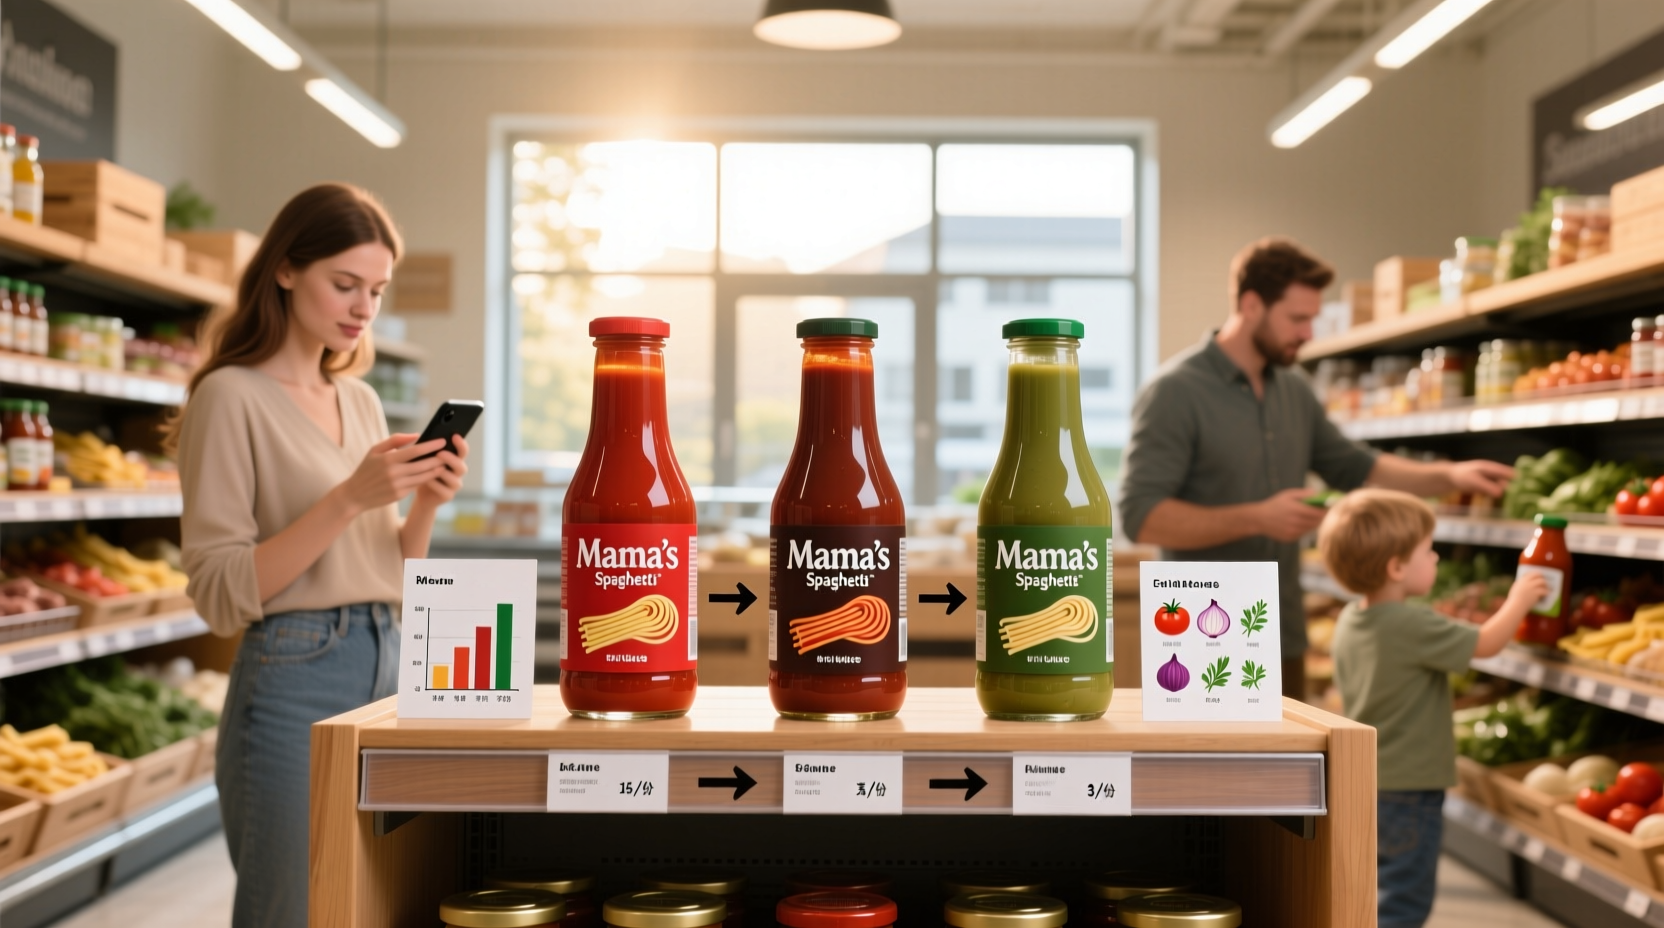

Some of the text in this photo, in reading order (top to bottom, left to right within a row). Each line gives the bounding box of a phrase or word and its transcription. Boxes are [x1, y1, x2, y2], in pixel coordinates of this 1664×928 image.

[576, 538, 679, 569] Mama's
[787, 539, 890, 570] Mama's
[995, 539, 1098, 570] Mama's
